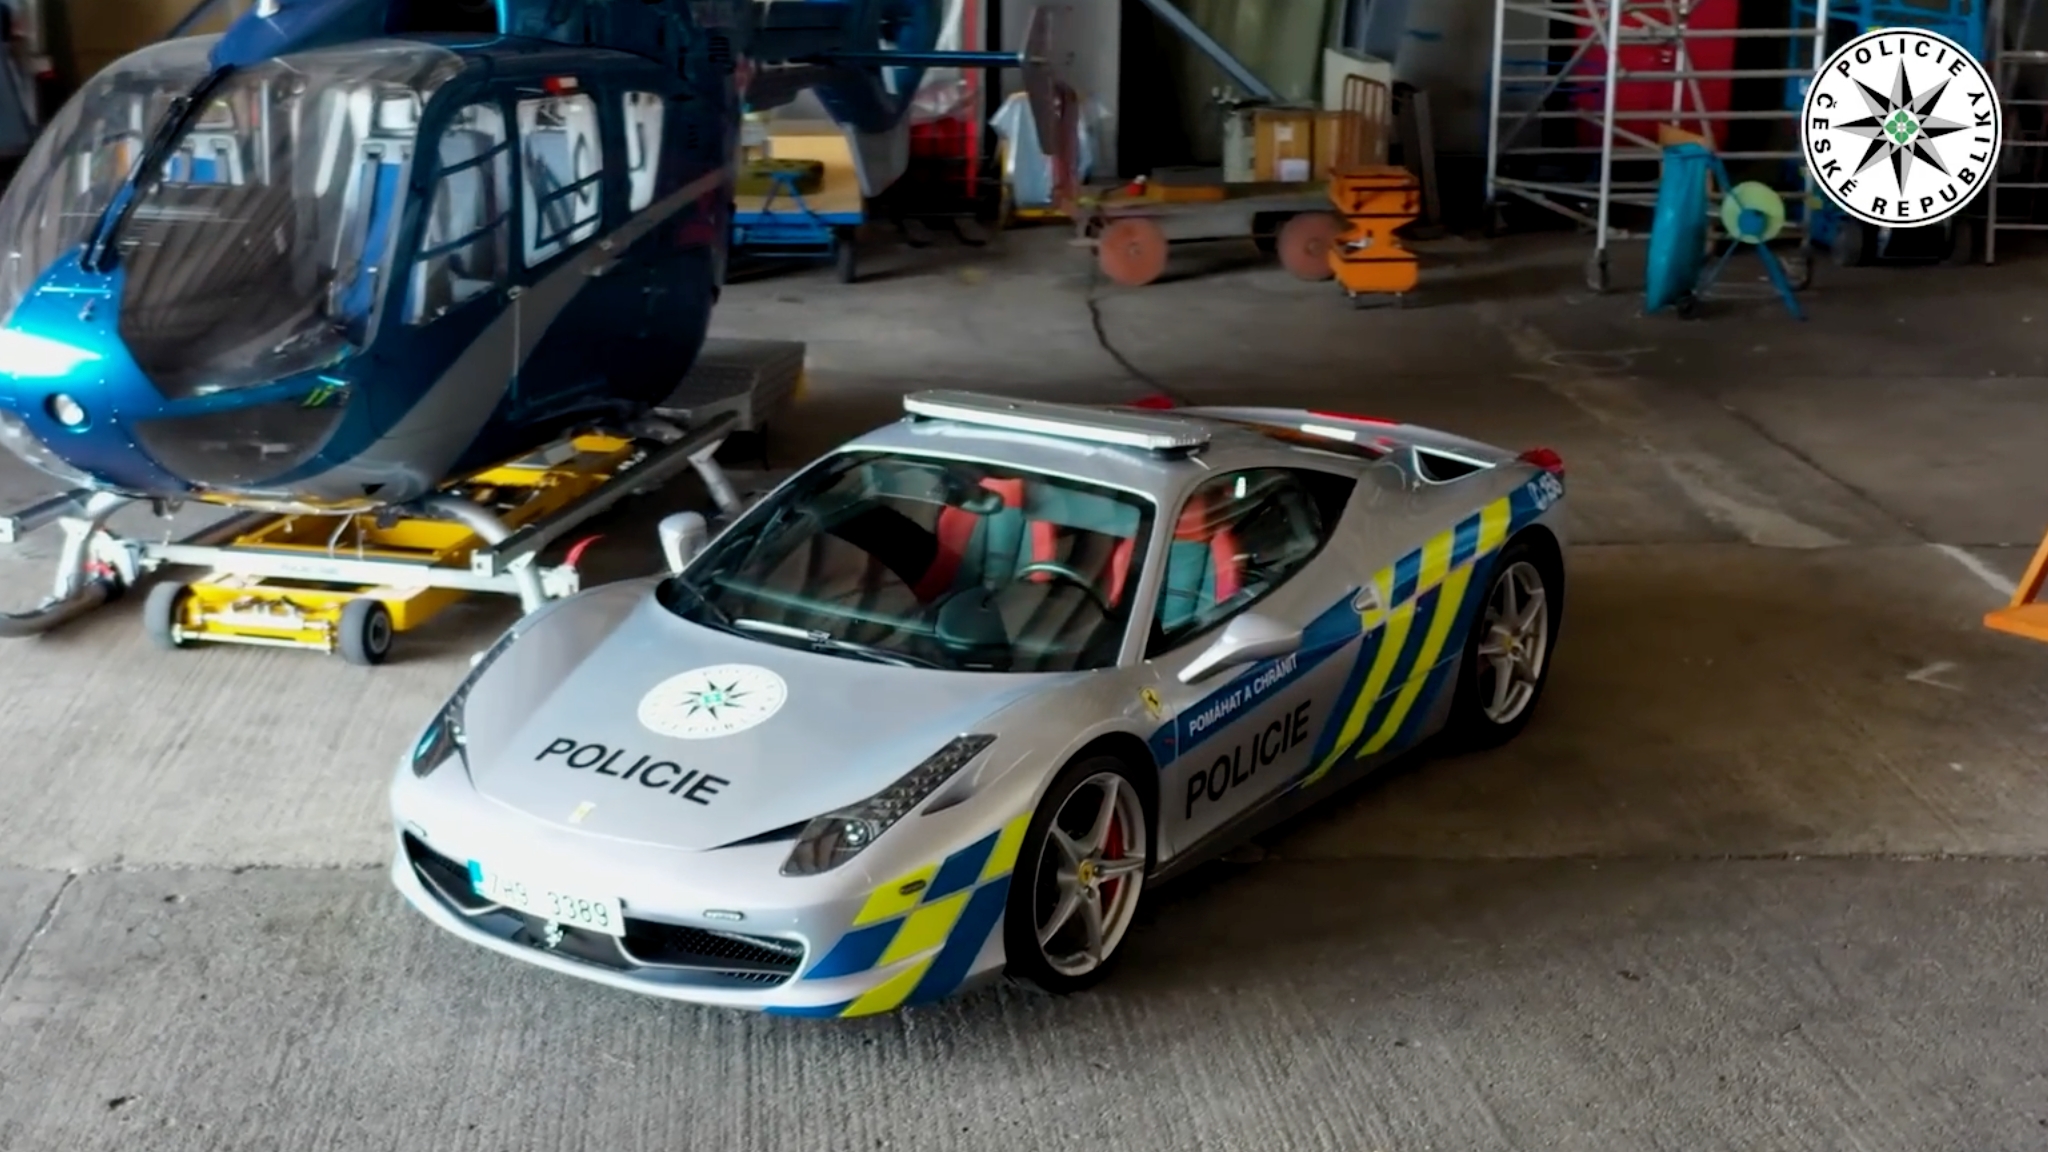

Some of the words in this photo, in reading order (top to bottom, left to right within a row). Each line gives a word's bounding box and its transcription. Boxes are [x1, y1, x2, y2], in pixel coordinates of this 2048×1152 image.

[1189, 689, 1242, 737] POMÁHAT
[1244, 686, 1253, 702] A
[1253, 652, 1297, 694] CHRÁNIT
[534, 737, 731, 806] POLICIE
[1185, 699, 1311, 820] POLICIE
[547, 891, 609, 927] 3389
